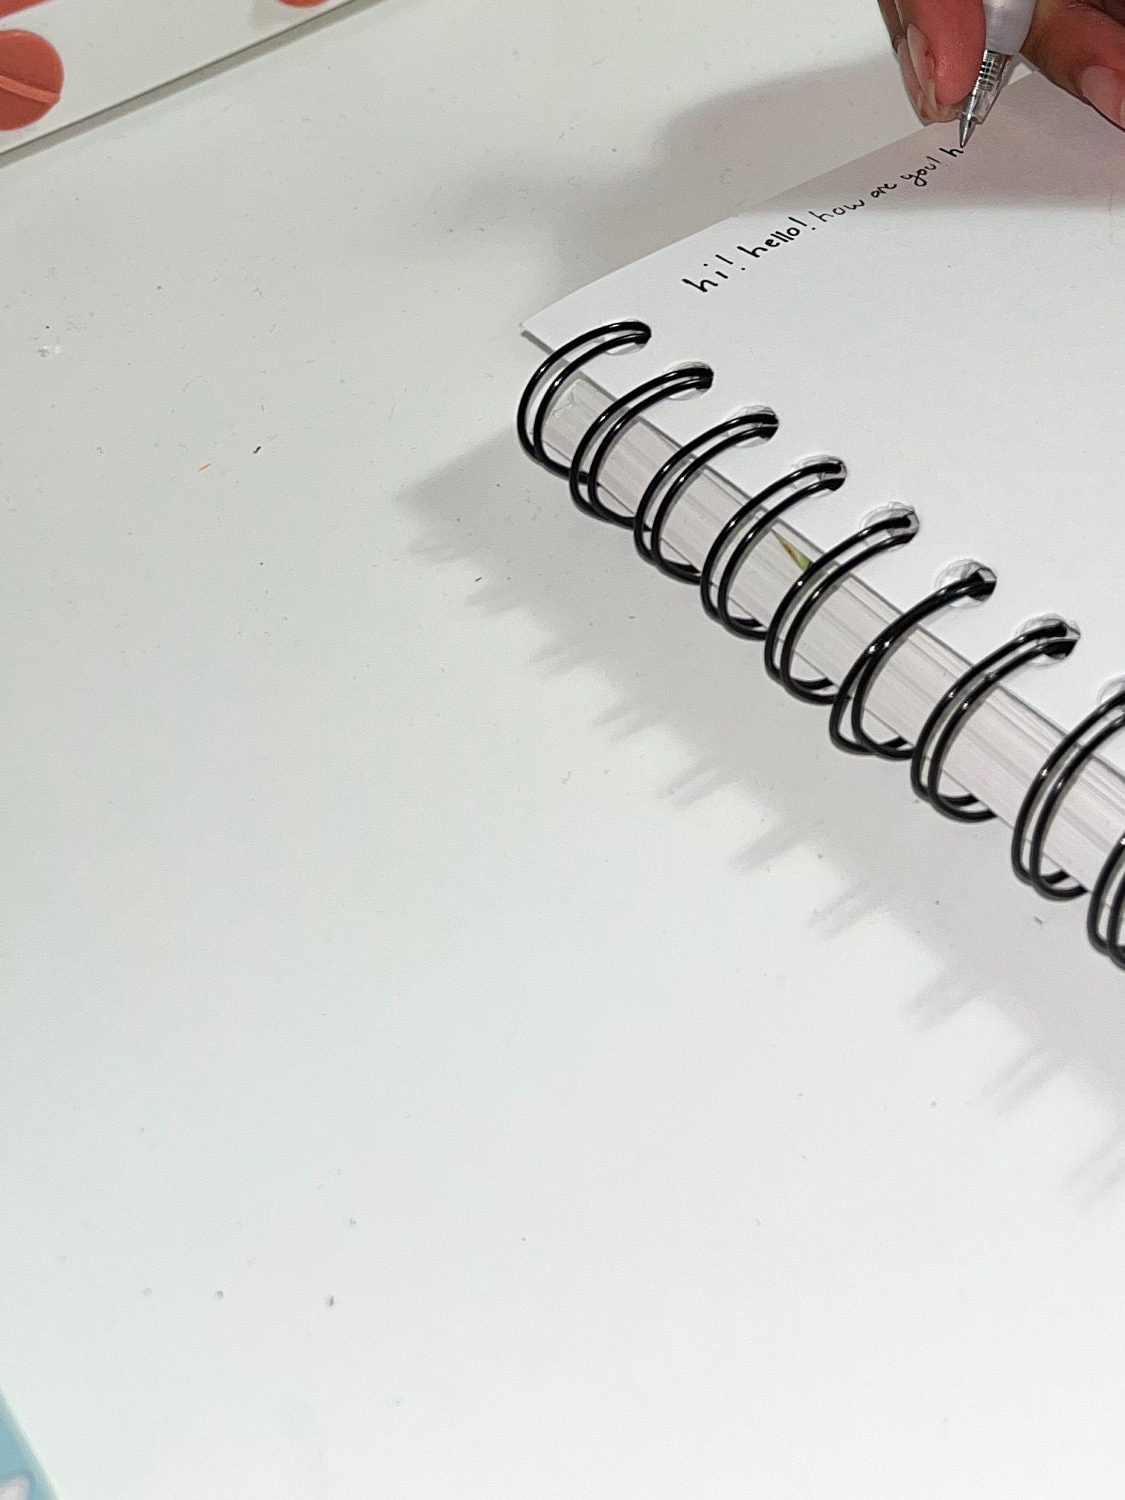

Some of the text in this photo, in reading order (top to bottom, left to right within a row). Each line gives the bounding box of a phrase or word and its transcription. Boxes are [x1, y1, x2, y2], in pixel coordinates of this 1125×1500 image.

[681, 253, 746, 293] hi!
[736, 216, 816, 259] hello!
[808, 199, 866, 223] how
[870, 182, 898, 199] are
